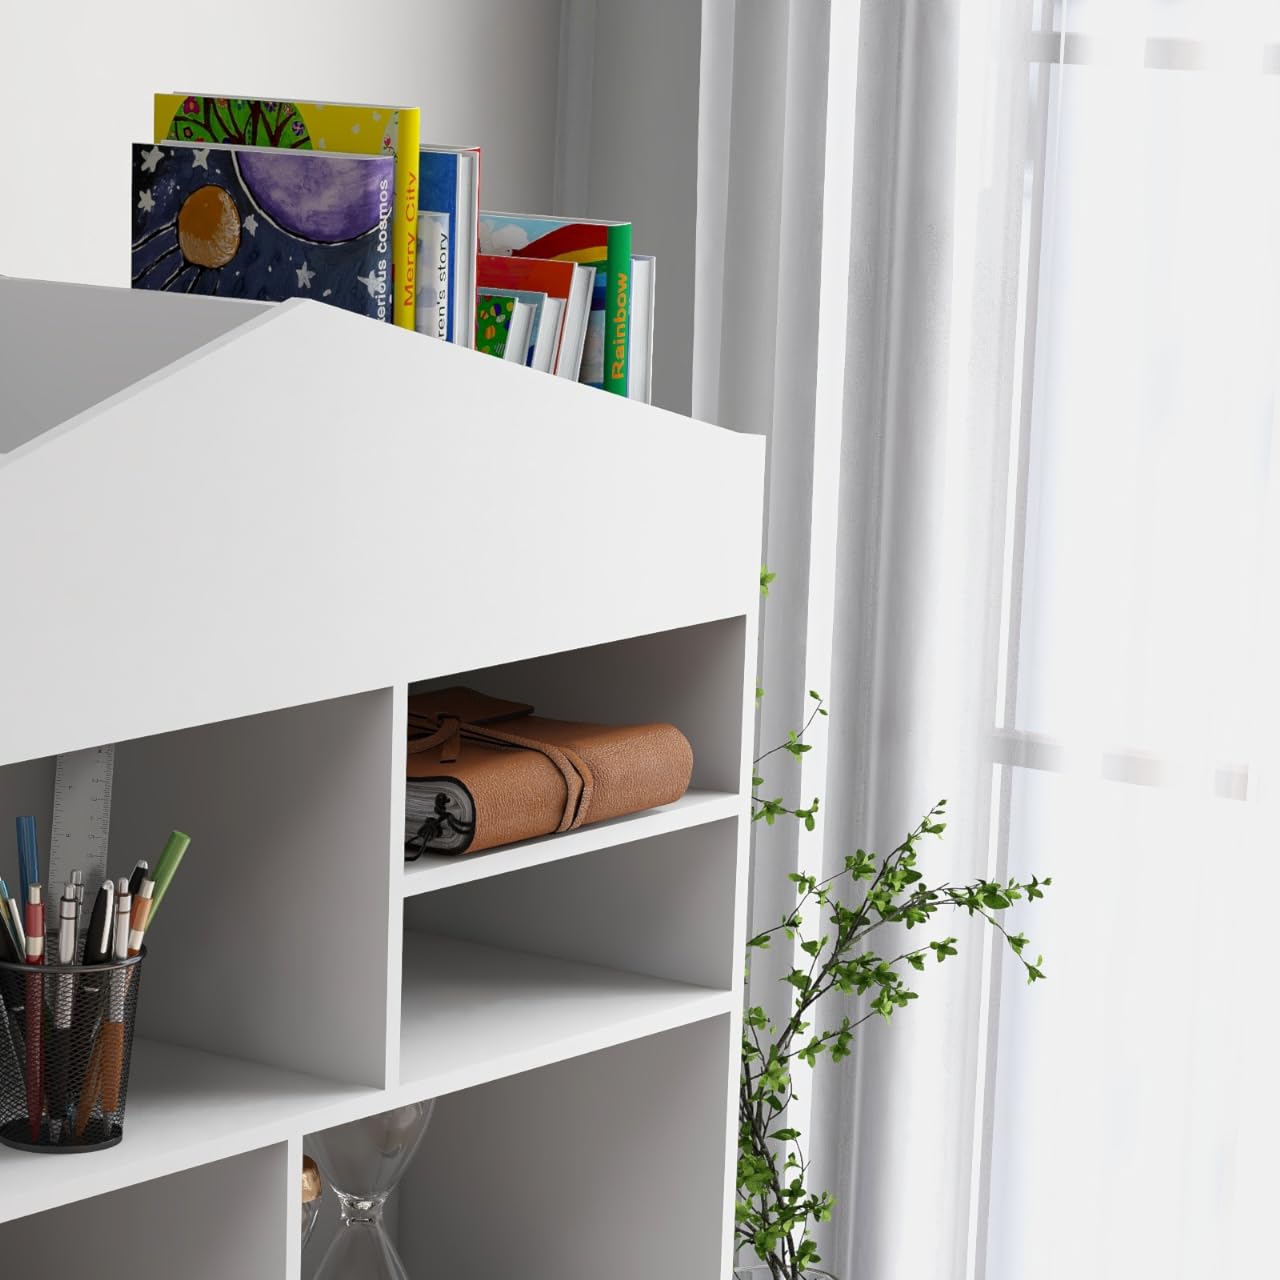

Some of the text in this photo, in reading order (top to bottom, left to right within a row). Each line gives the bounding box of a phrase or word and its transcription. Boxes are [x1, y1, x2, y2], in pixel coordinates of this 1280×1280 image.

[378, 179, 388, 253] cosmos
[403, 172, 417, 307] Merry City
[436, 233, 448, 340] ren's story
[611, 273, 628, 379] Rainbow
